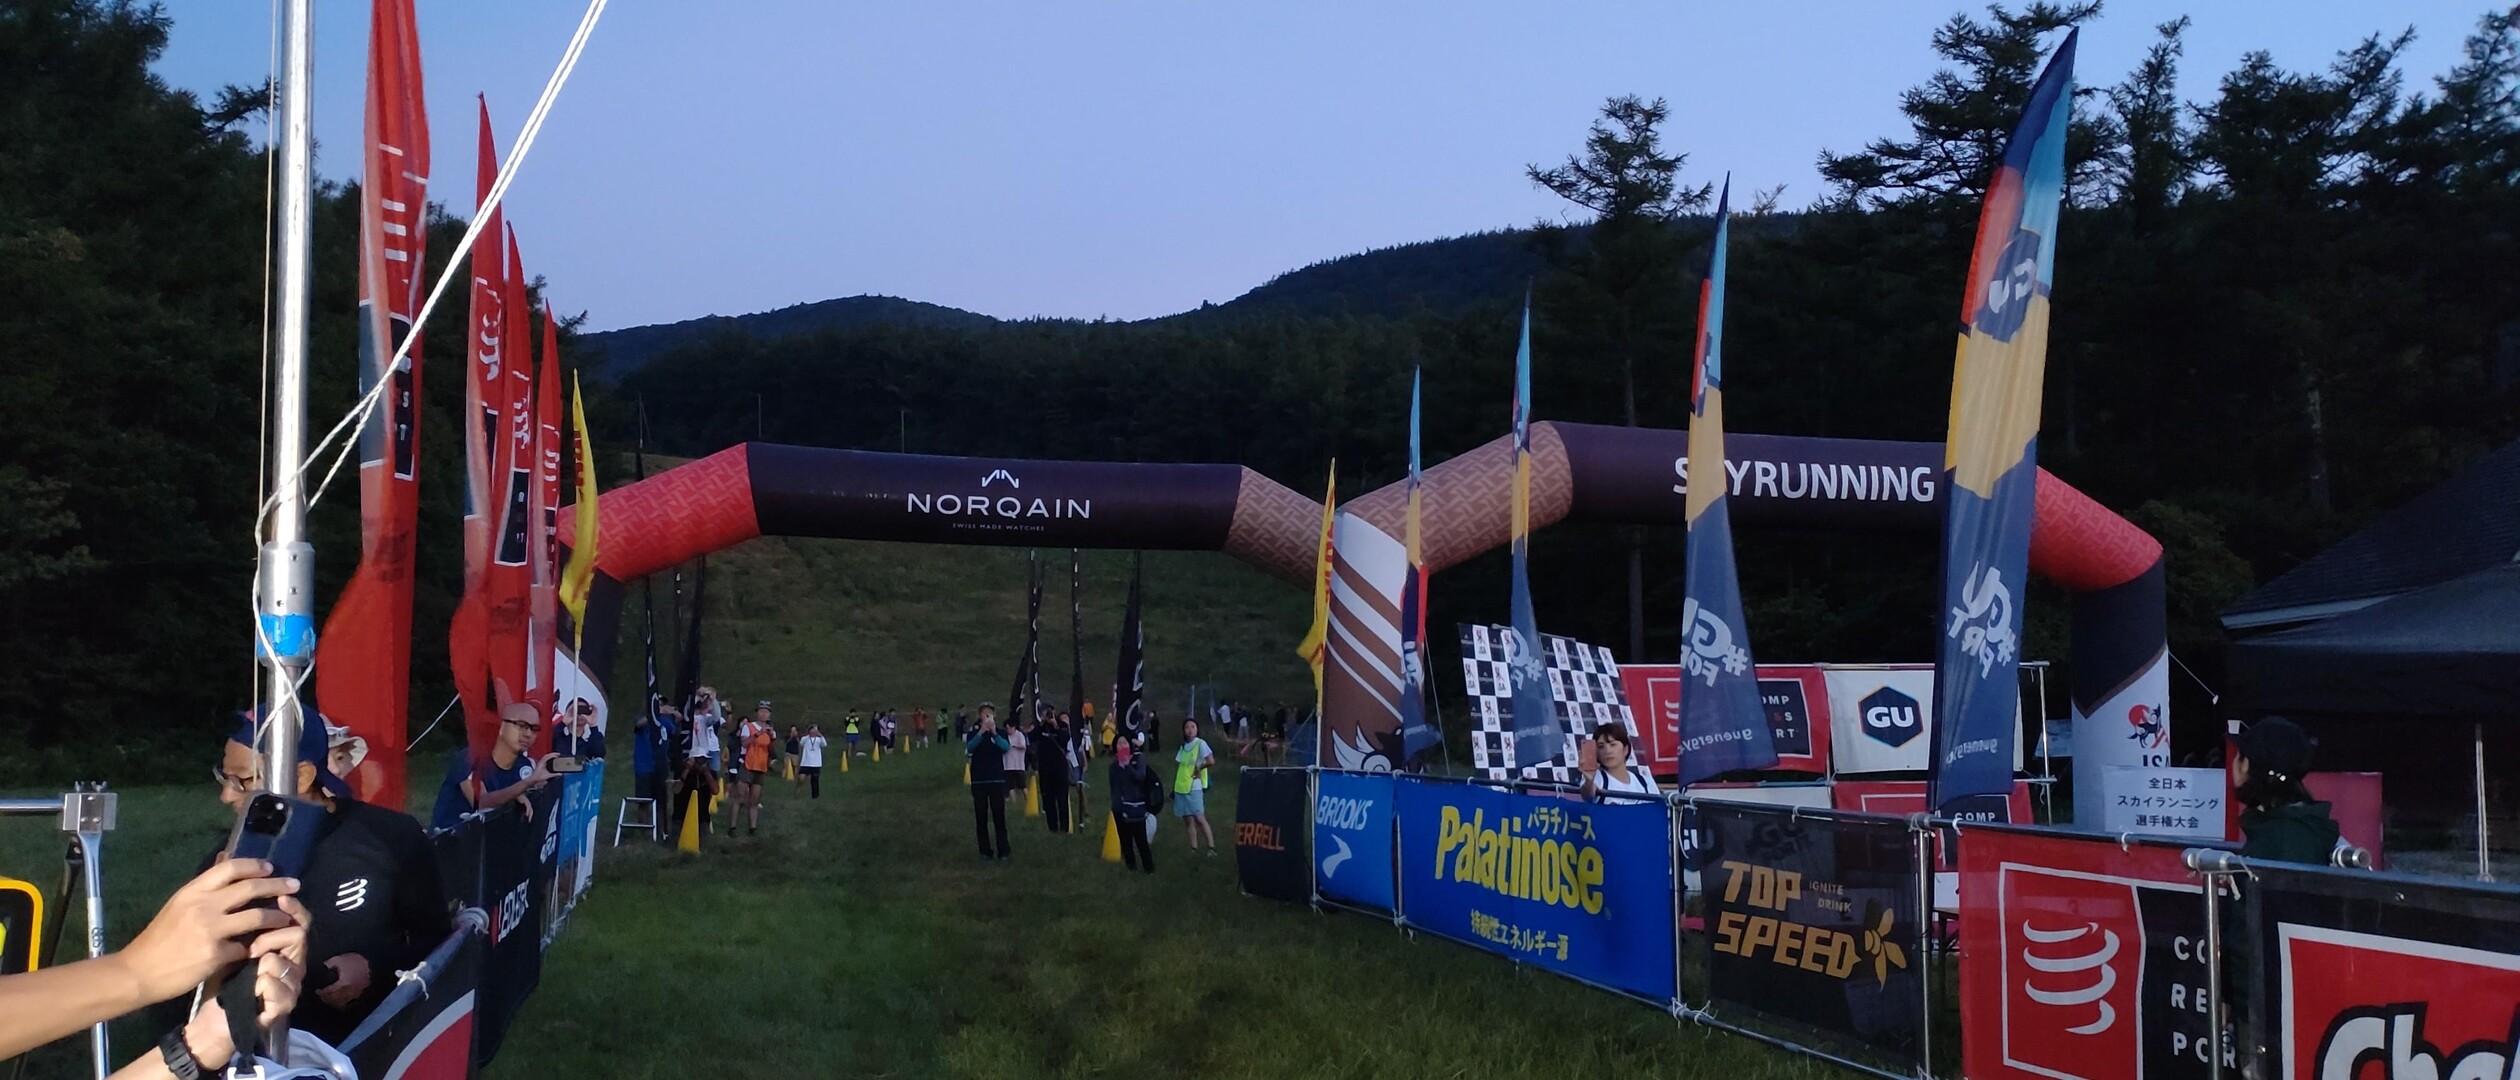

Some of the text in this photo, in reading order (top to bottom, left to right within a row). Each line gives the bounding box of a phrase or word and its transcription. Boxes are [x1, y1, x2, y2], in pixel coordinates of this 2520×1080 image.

[1672, 457, 1935, 503] SYRUNNING
[907, 492, 1090, 519] NORQAIN
[952, 522, 1045, 532] SWISS MADE WATCHES
[1866, 705, 1915, 729] GU
[2148, 777, 2187, 790] 全日本
[1315, 795, 1374, 831] BROOKS
[2117, 795, 2218, 810] スカイランニング
[2135, 814, 2199, 829] 選手権大会
[1435, 805, 1604, 915] Palatinose
[1721, 860, 1802, 911] TOP
[1809, 880, 1844, 896] IGNITE
[1818, 898, 1852, 913] DRINK
[1713, 911, 1862, 979] SPEED
